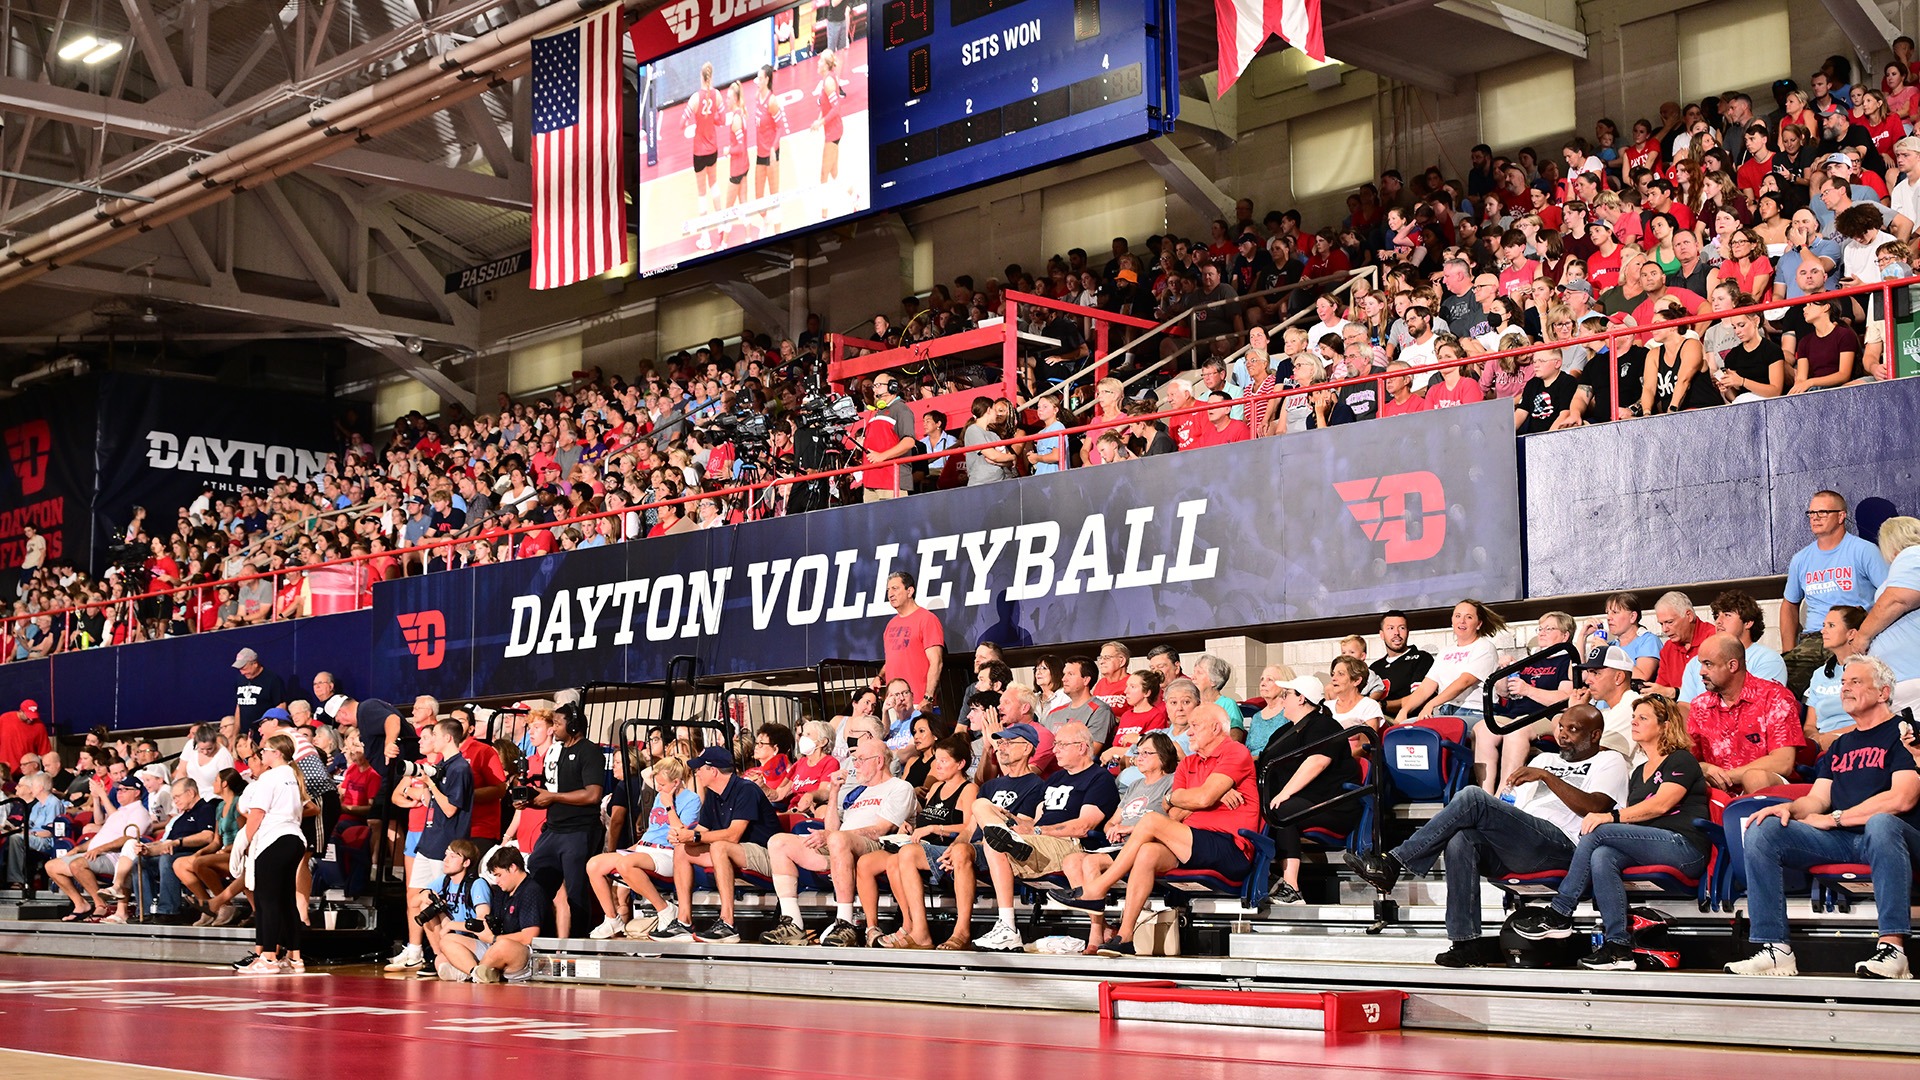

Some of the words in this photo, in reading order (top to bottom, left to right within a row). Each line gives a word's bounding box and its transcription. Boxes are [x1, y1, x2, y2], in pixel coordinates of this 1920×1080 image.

[961, 34, 999, 66] SETS
[1003, 19, 1041, 51] WON
[910, 48, 928, 94] 0
[1102, 54, 1110, 70] 4
[1031, 77, 1039, 93] 3
[701, 98, 713, 115] 22
[965, 98, 973, 114] 2
[903, 119, 910, 133] 1
[459, 255, 521, 289] PASSION
[642, 263, 679, 279] DAKTRONICS
[146, 430, 330, 484] DAYTON
[0, 496, 64, 539] DAYTON
[0, 530, 63, 569] FLYRS
[746, 498, 1220, 630] VOLLEYBALL
[1806, 565, 1853, 584] DAYTON
[504, 566, 733, 659] DAYTON
